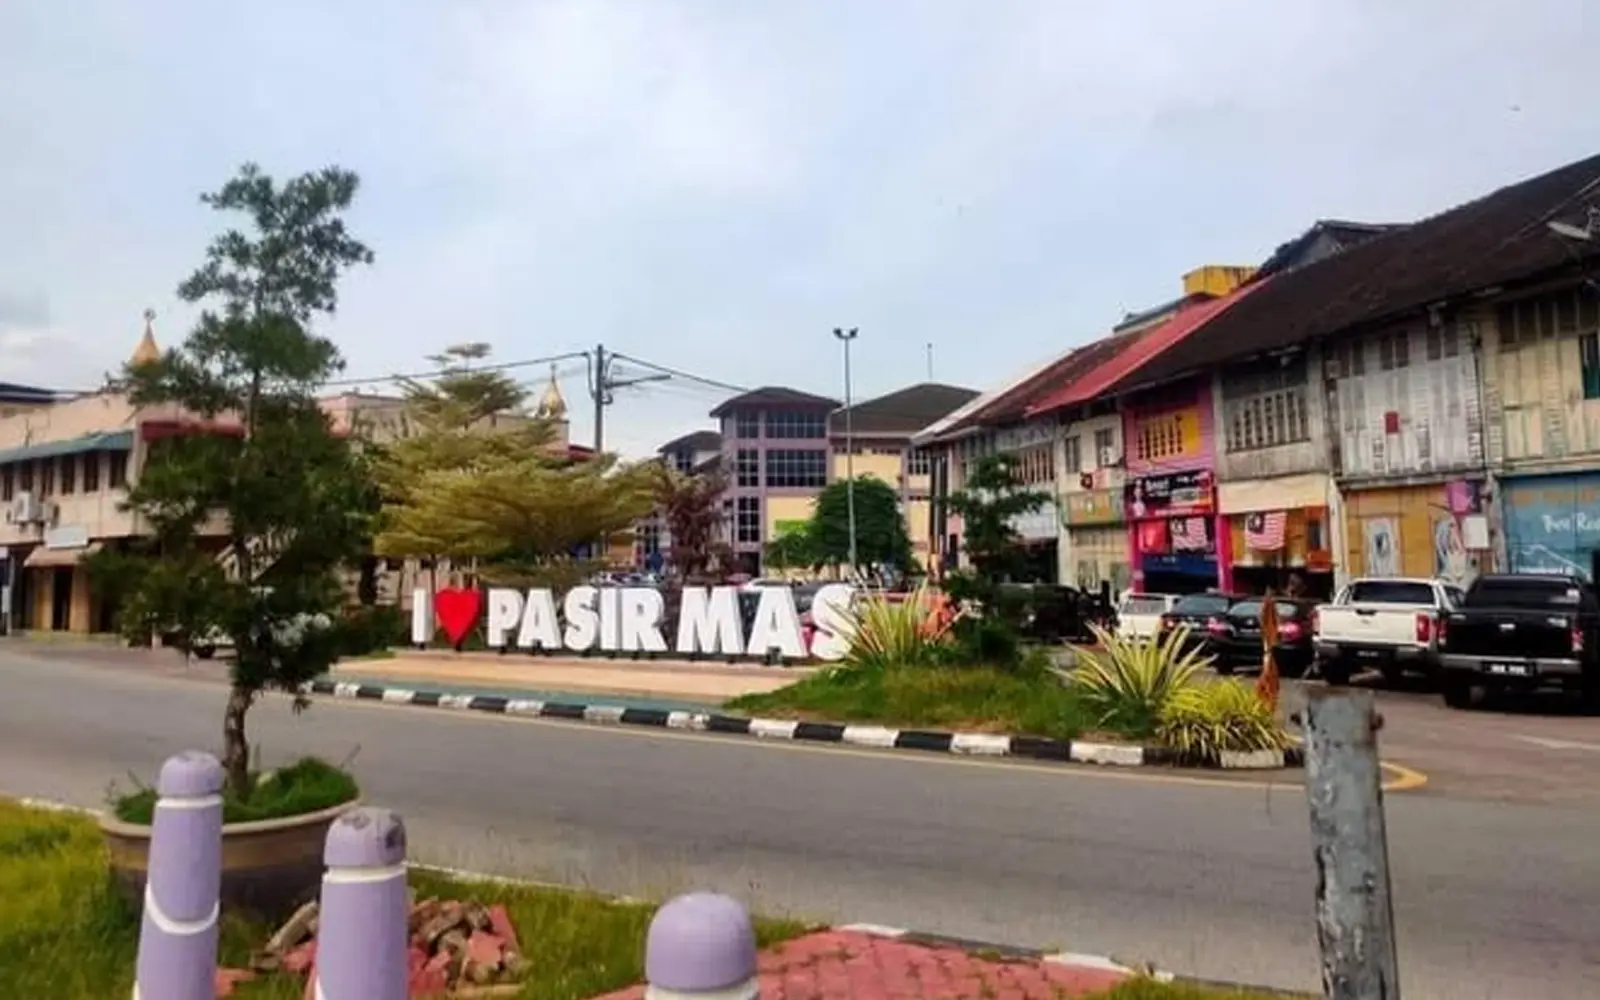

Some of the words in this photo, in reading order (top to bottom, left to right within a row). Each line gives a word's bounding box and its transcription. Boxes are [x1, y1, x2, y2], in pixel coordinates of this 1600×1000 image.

[411, 587, 432, 643] I
[487, 586, 668, 651] PASIR
[676, 583, 857, 661] MAS
